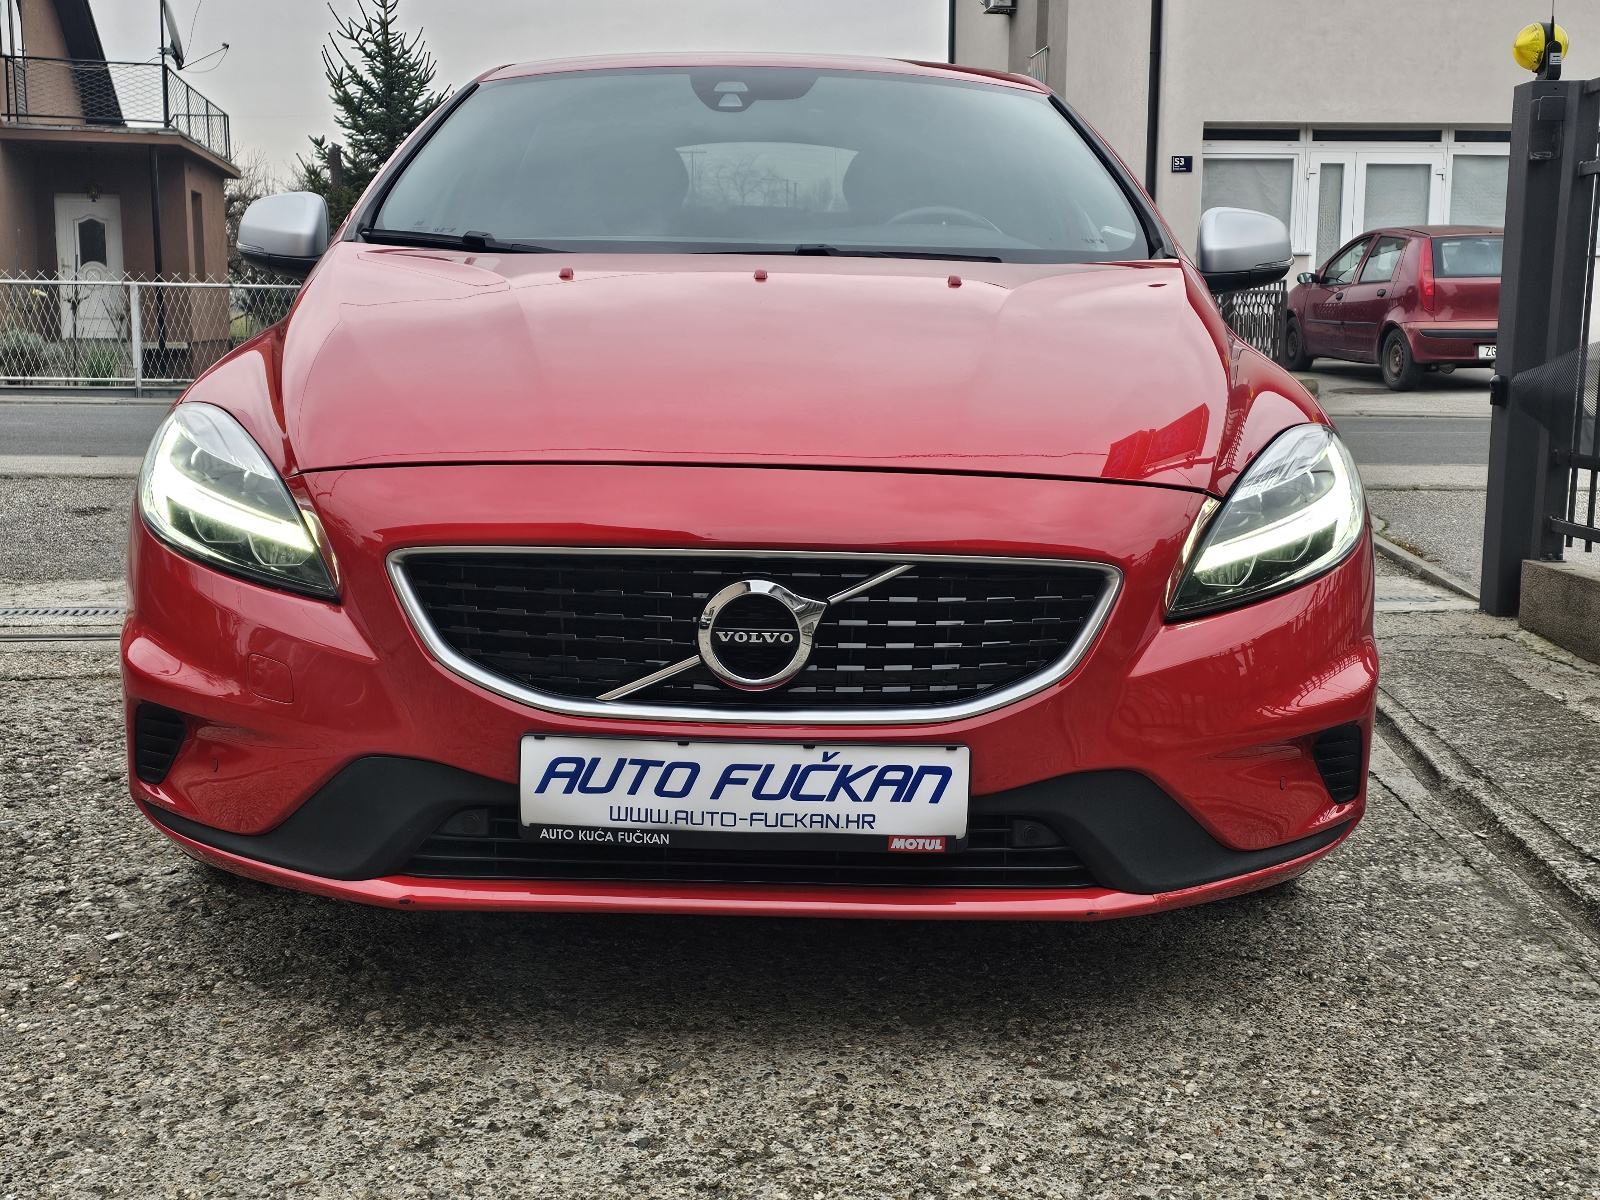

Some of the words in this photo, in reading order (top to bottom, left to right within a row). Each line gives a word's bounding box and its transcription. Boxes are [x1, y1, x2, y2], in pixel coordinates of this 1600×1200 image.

[715, 631, 794, 644] VOLVO
[534, 756, 701, 798] AUTO
[709, 751, 953, 804] FUČKAN
[609, 805, 876, 830] WWW.AUTO-FUCKAN.HR
[539, 828, 574, 840] AUTO
[578, 828, 614, 843] KUĆA
[618, 829, 670, 845] FUČKAN
[890, 837, 943, 851] MOTUL
